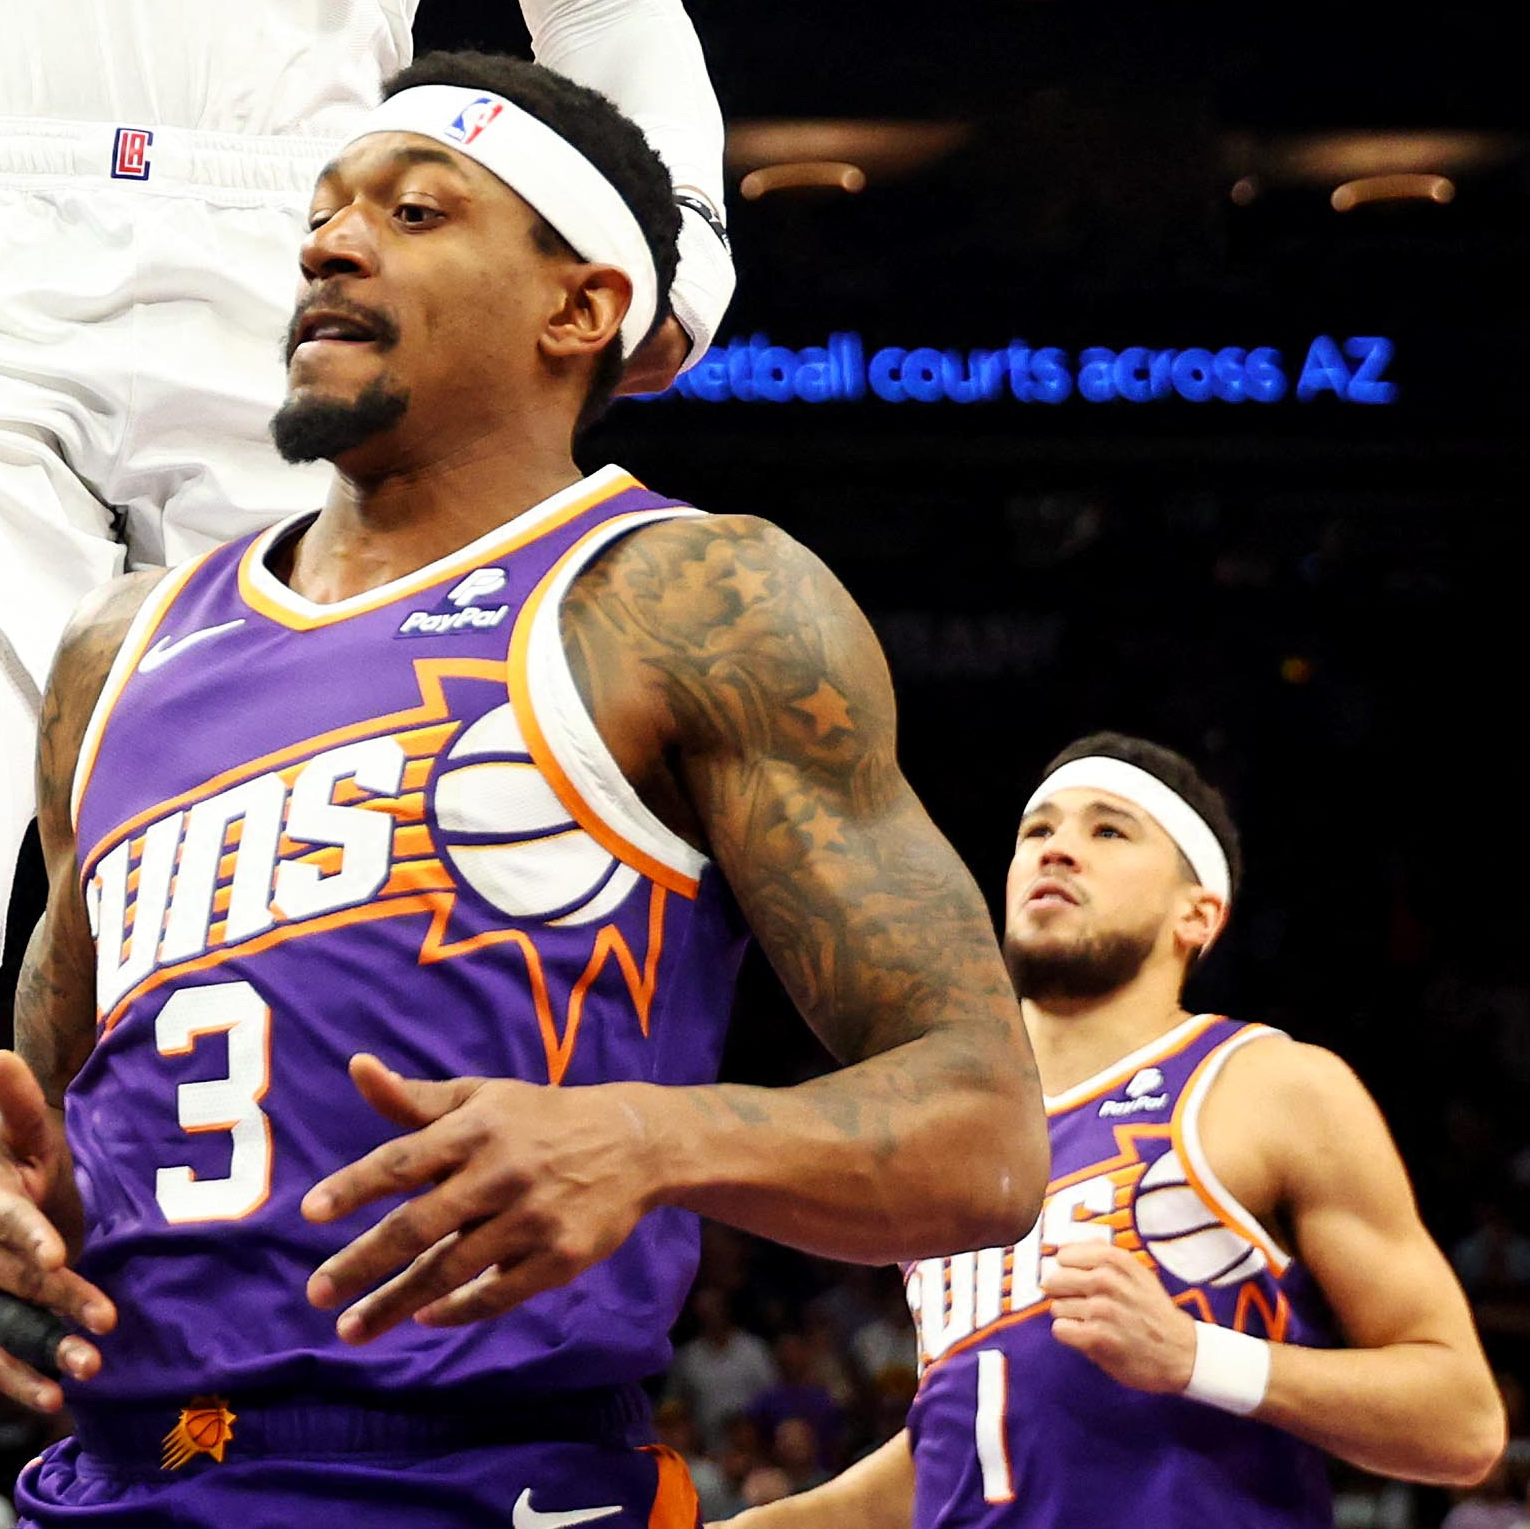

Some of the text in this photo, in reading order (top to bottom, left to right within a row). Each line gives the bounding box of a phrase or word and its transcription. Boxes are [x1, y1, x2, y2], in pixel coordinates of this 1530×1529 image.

[676, 331, 864, 403] etball
[867, 337, 1071, 403] courts
[1077, 345, 1285, 403] across
[1297, 334, 1397, 404] AZ
[398, 604, 509, 633] PayPal
[85, 734, 407, 1016] UNS
[155, 981, 272, 1223] 3
[976, 1348, 1017, 1504] 1
